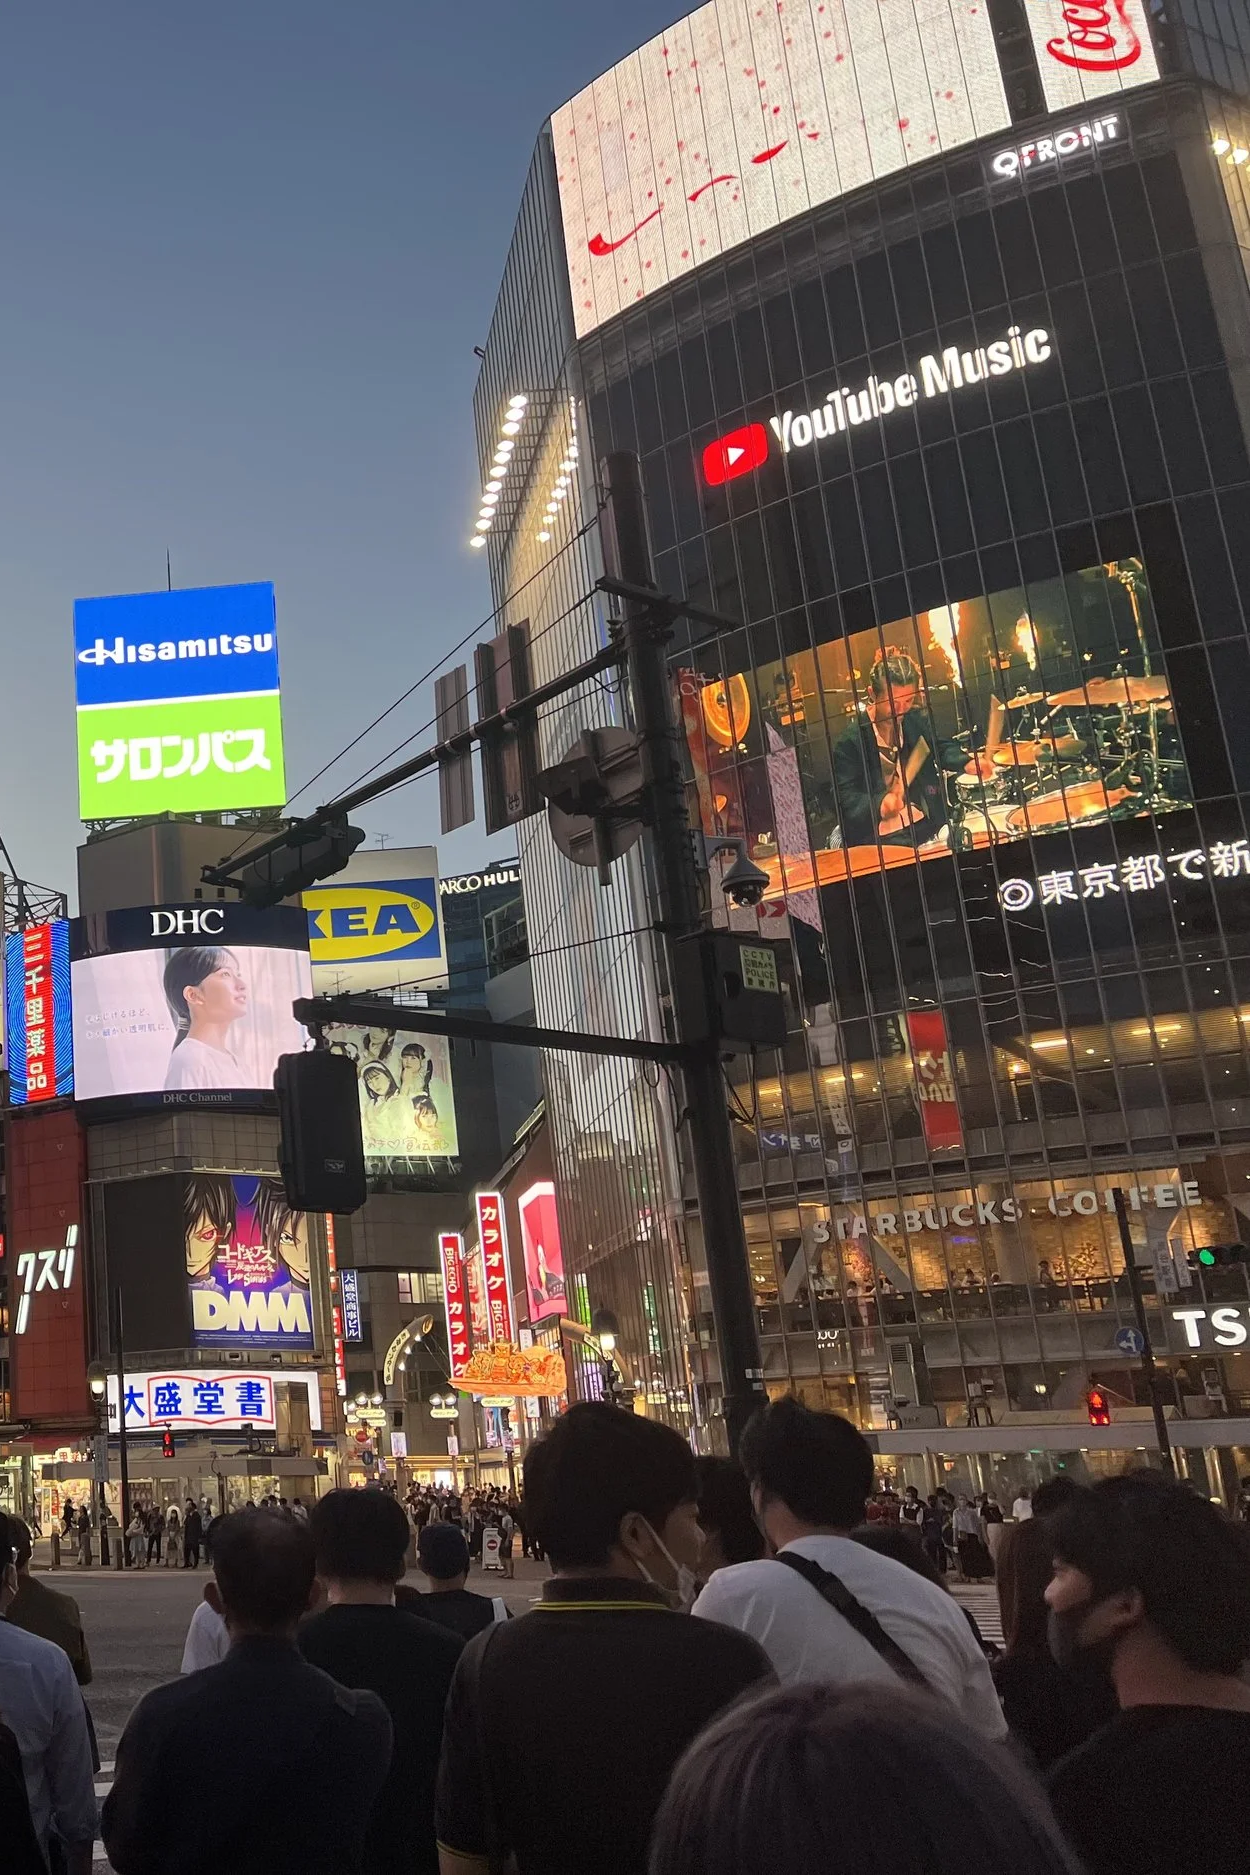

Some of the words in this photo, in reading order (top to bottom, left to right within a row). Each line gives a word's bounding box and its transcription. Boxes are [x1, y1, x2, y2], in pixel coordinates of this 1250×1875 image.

[993, 117, 1118, 178] QFRONT
[769, 374, 919, 453] YouTube
[920, 325, 1051, 397] Music
[78, 633, 273, 666] Hisamitsu
[90, 728, 272, 784] サロンパス
[150, 908, 224, 936] DHC
[743, 950, 772, 961] CCTV
[746, 968, 775, 980] POLICE
[24, 932, 47, 1091] 三千里薬品
[163, 1093, 187, 1104] DHC
[189, 1092, 232, 1103] Channel
[813, 1197, 1023, 1244] STARBUCKS
[216, 1243, 277, 1264] コードギアス
[444, 1247, 453, 1268] BIG
[481, 1206, 504, 1290] カラオケ
[15, 1224, 78, 1335] クスリ
[447, 1267, 458, 1294] ECHO
[192, 1290, 311, 1333] DMM
[344, 1272, 359, 1338] 大盛堂商事ビル
[491, 1300, 502, 1322] BIG
[449, 1301, 467, 1377] カラオケ
[1173, 1308, 1250, 1347] TS
[124, 1381, 266, 1418] 大盛堂書
